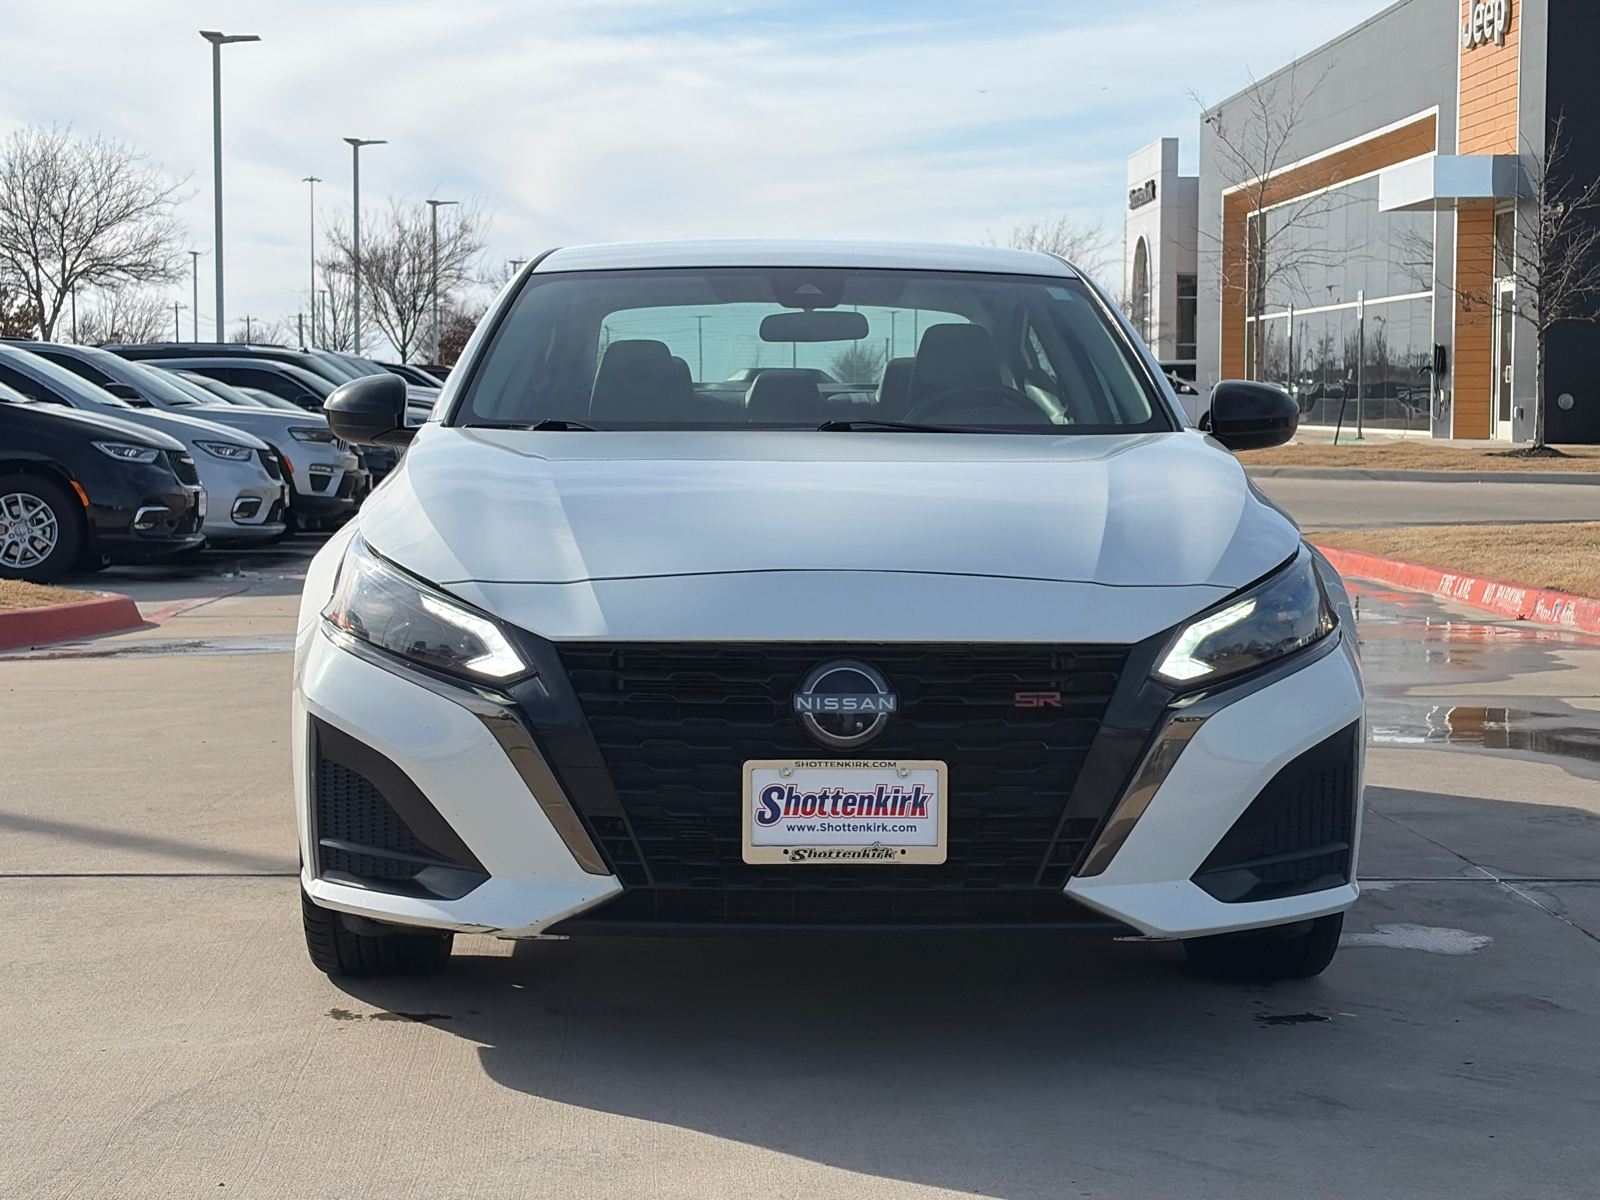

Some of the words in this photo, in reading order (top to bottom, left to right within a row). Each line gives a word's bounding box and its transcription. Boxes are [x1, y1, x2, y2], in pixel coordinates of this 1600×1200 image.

[1462, 0, 1509, 48] Jeep
[1481, 583, 1496, 604] NO
[796, 696, 894, 710] NISSAN
[1014, 691, 1062, 707] SR
[755, 783, 933, 827] Shottenkirk
[786, 822, 917, 833] www.Shottenkirk.com
[789, 847, 897, 862] Shottenkirk
